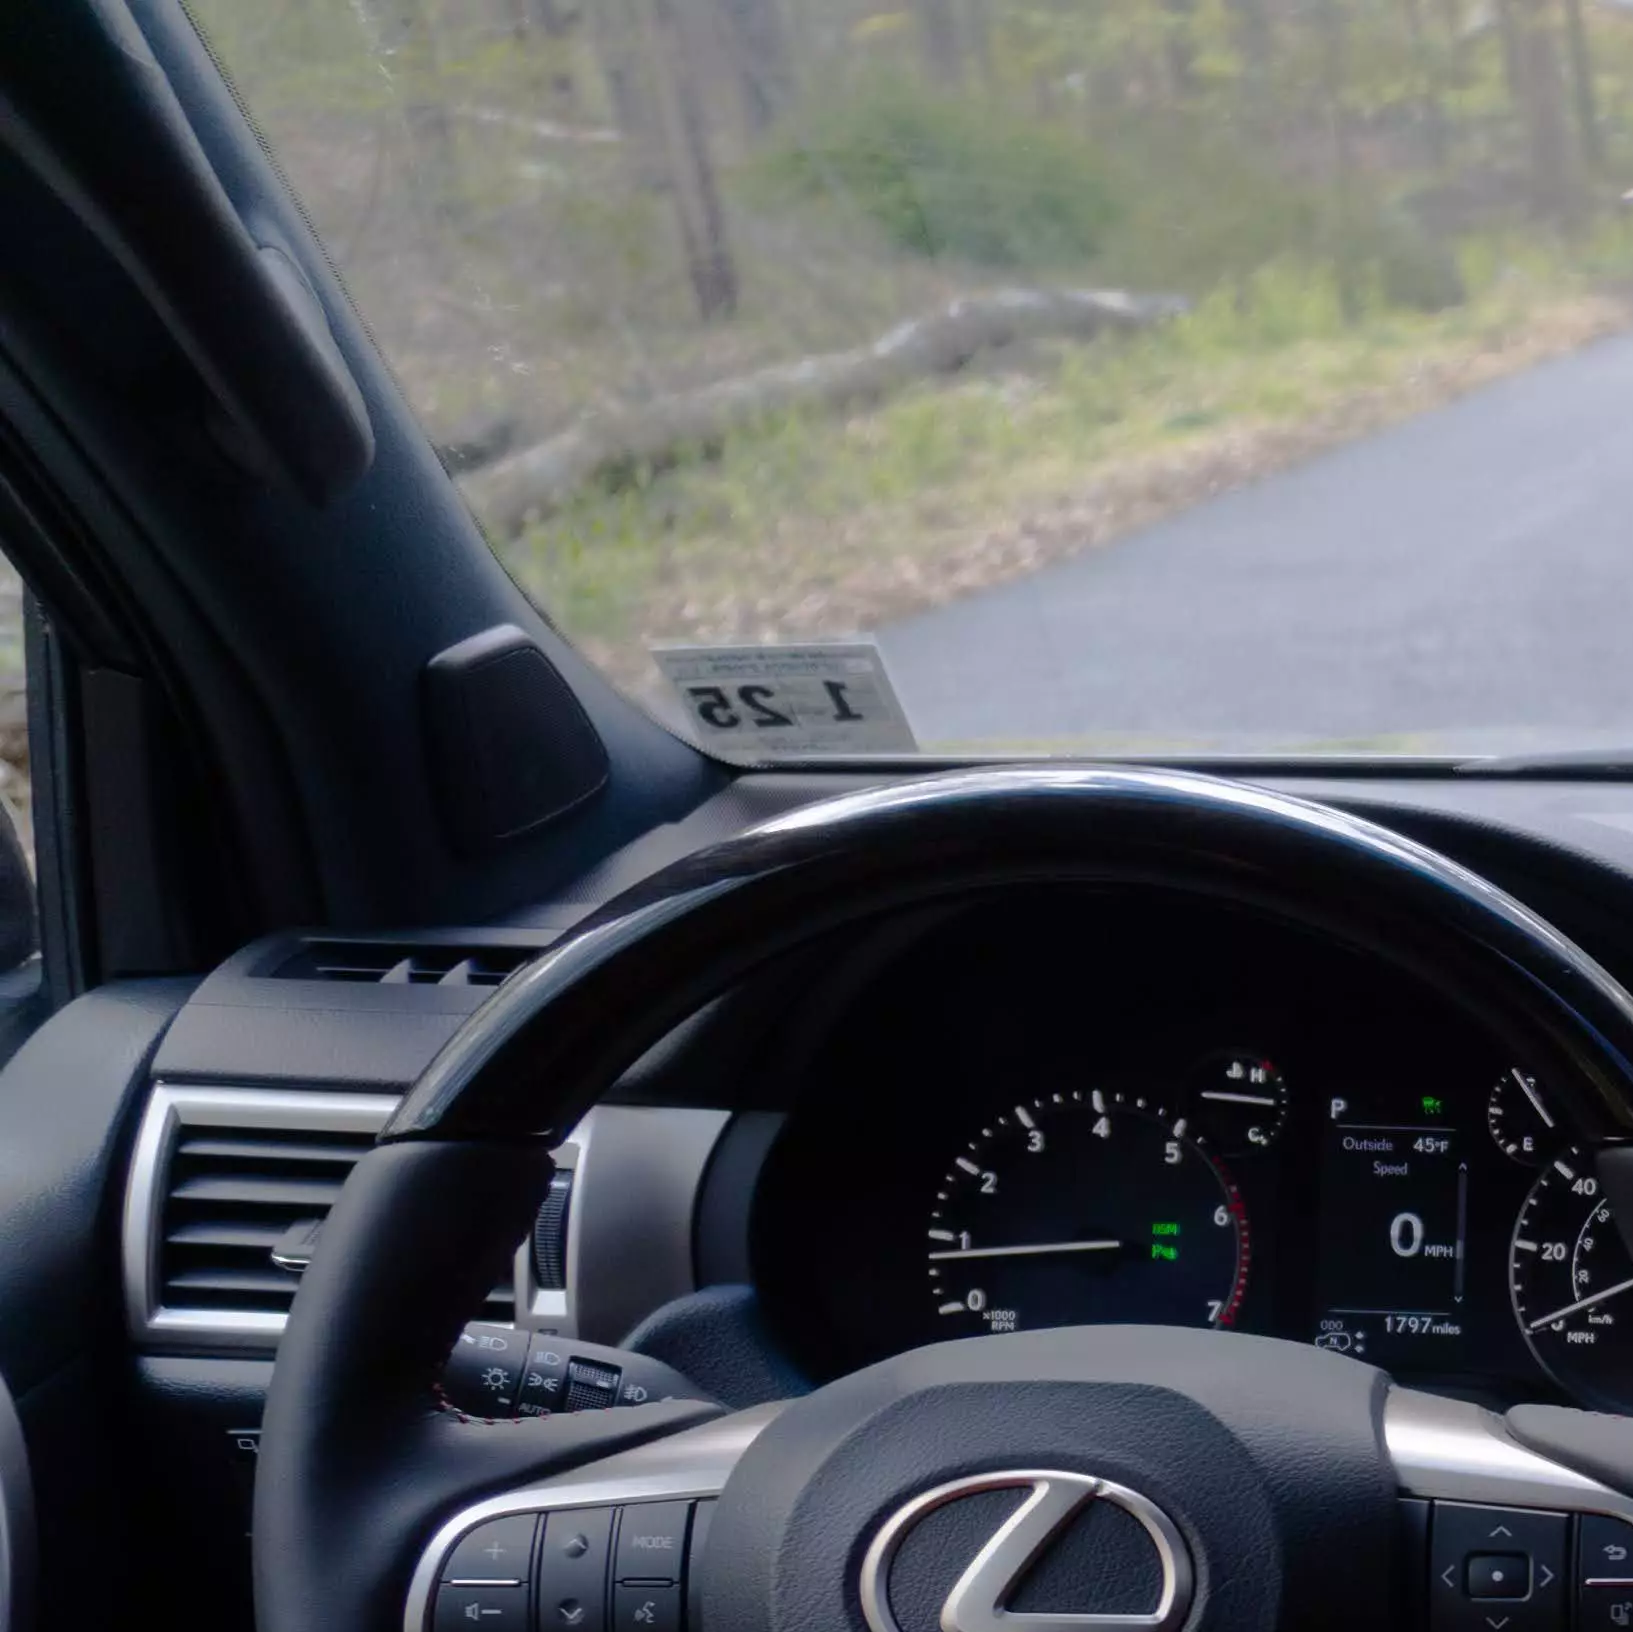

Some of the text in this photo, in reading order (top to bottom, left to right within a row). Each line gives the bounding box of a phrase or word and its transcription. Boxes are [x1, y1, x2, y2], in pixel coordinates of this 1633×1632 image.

[1329, 1097, 1348, 1120] P
[1093, 1117, 1109, 1137] 4
[1028, 1131, 1043, 1152] 3
[1343, 1137, 1392, 1150] Outside
[1523, 1137, 1533, 1151] E
[1165, 1142, 1181, 1163] 5
[1374, 1161, 1407, 1176] Speed
[981, 1172, 996, 1193] 2
[1571, 1177, 1598, 1196] 40
[1214, 1206, 1228, 1226] 6
[1389, 1211, 1454, 1258] 0 MPH
[1542, 1243, 1566, 1260] 20
[967, 1289, 985, 1311] 0
[1206, 1300, 1223, 1323] 7
[1319, 1315, 1462, 1335] ODO 1797 miles
[1567, 1332, 1594, 1343] MPH
[632, 1535, 672, 1548] MODE
